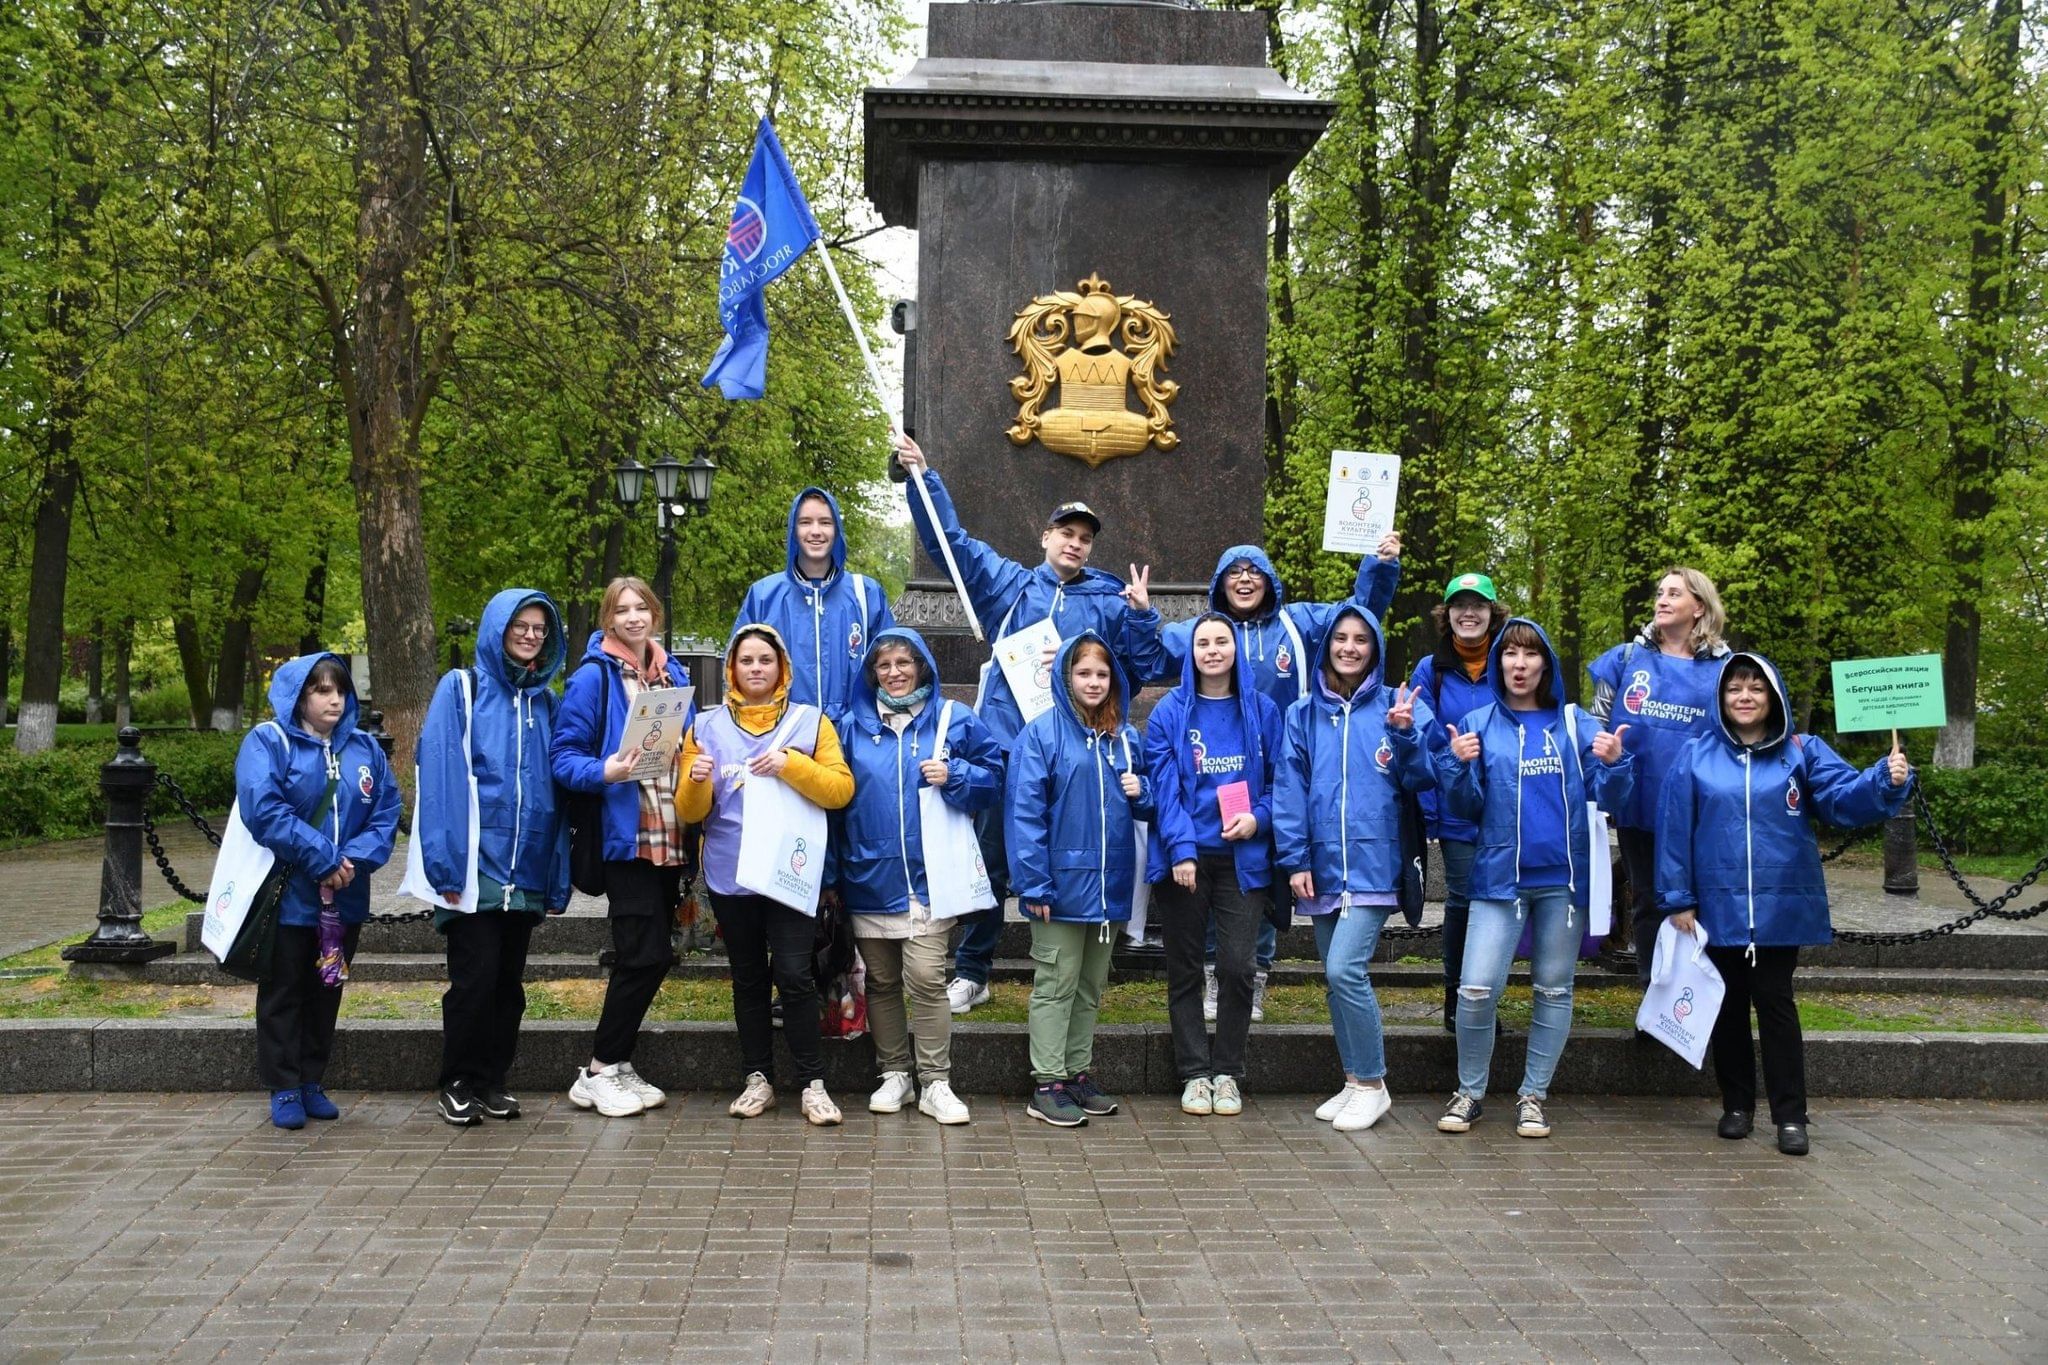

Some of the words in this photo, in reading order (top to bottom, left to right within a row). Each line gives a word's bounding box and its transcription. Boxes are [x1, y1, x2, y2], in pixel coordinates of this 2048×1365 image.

[1844, 666, 1903, 680] Всероссийская
[1845, 684, 1893, 694] «Бегущая
[1895, 681, 1930, 690] книга»
[1640, 708, 1692, 723] КУЛЬТУРЫ
[1641, 700, 1706, 717] ВОЛОНТЕРЫ
[777, 869, 813, 890] ВОЛОНТЕРЫ
[778, 877, 809, 895] КУЛЬТУРЫ
[1659, 1013, 1696, 1041] ВОЛОНТЕРЫ
[1659, 1021, 1692, 1045] КУЛЬТУРЫ
